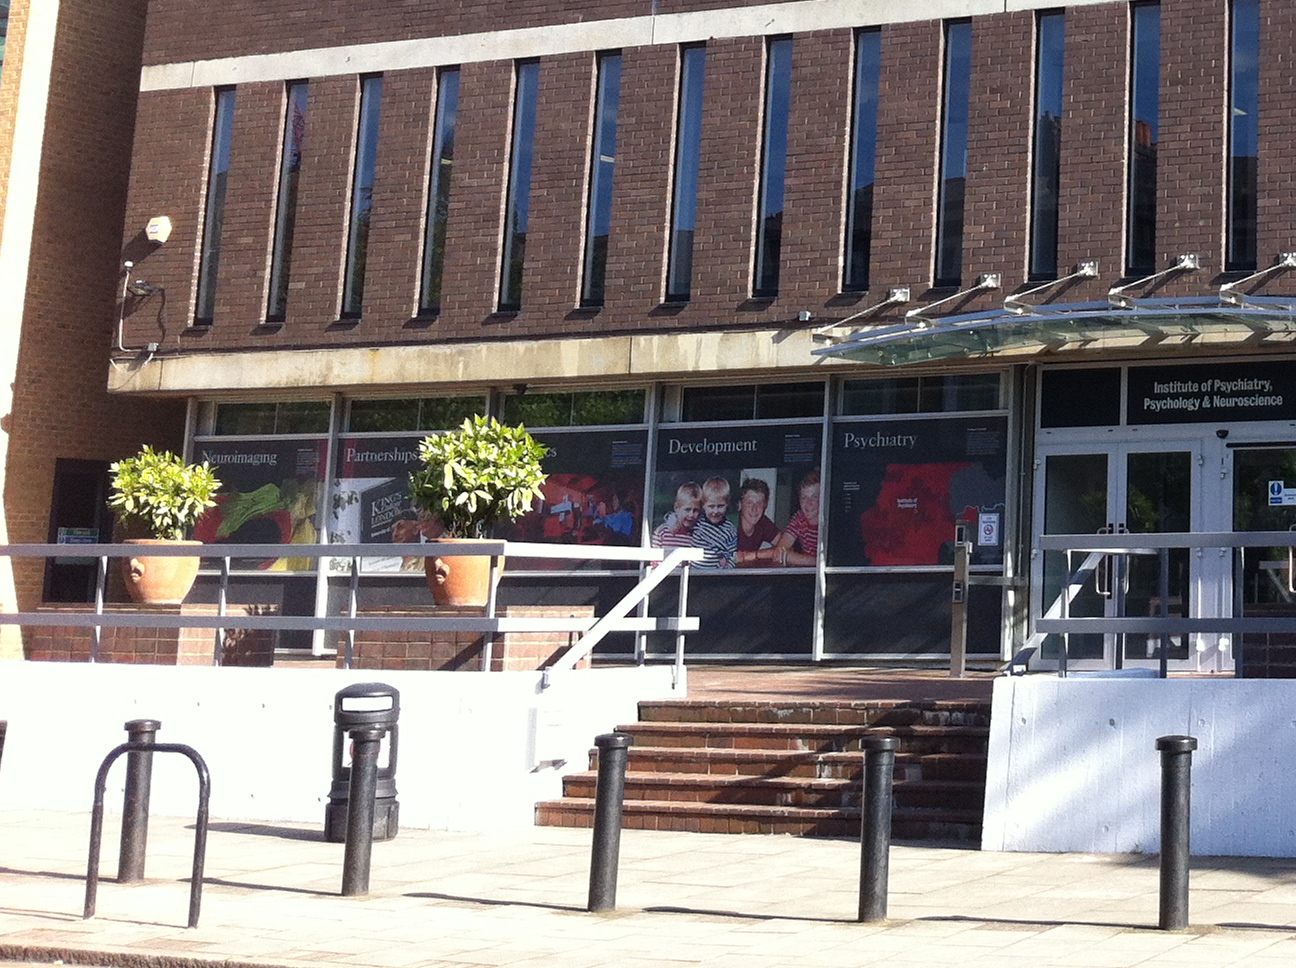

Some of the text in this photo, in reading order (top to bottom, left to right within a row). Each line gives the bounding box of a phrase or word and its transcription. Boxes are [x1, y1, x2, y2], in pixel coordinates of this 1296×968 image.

[1154, 378, 1273, 394] Institute of Psychiatry,
[1144, 394, 1283, 412] Psychology & Neuroscience
[669, 438, 757, 455] Development
[844, 432, 918, 450] Psychiatry
[202, 449, 277, 466] Neuroimaging
[346, 447, 418, 464] Partnerships
